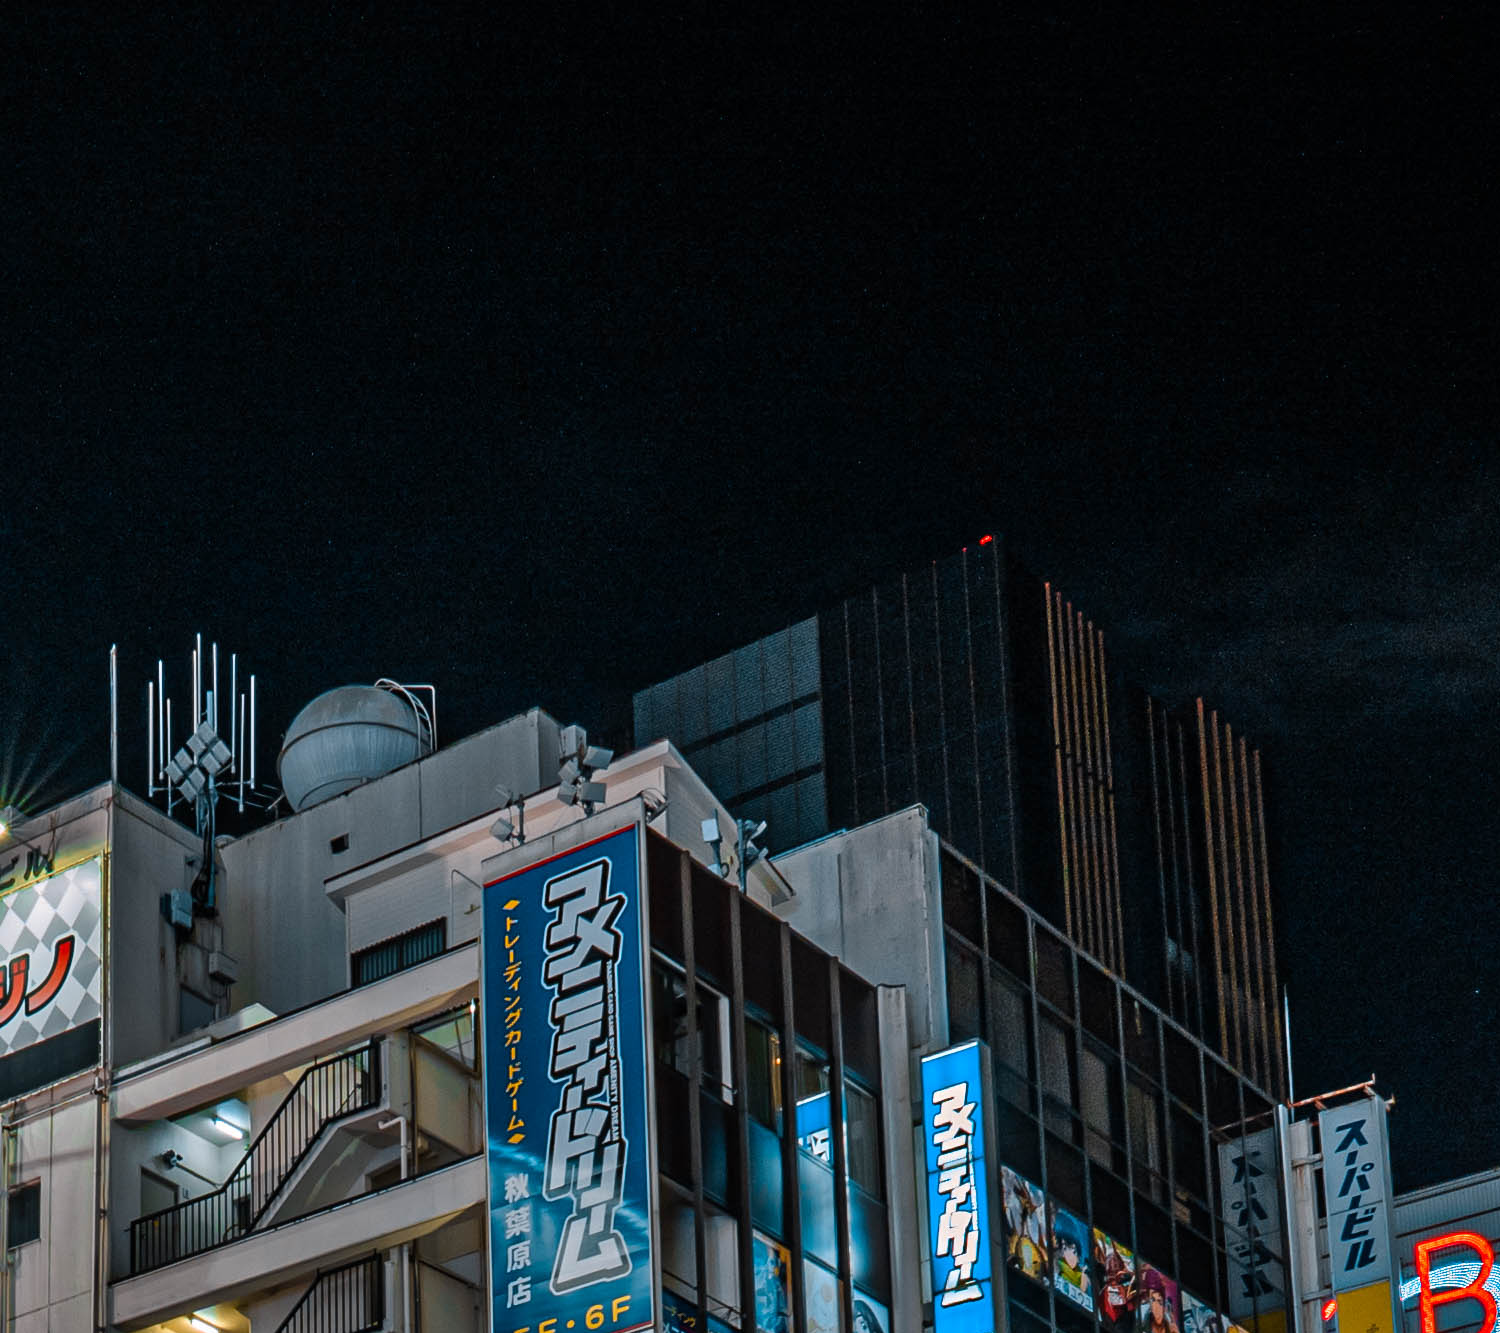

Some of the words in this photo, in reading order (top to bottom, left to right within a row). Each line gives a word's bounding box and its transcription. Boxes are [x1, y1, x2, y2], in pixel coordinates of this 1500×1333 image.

[502, 915, 526, 1133] トレーディングカードゲーム
[544, 858, 632, 1294] アメニティドリーム
[504, 1172, 532, 1308] 秋葉原店
[933, 1081, 984, 1308] アメニティドリーム
[1336, 1119, 1377, 1272] スーパービル
